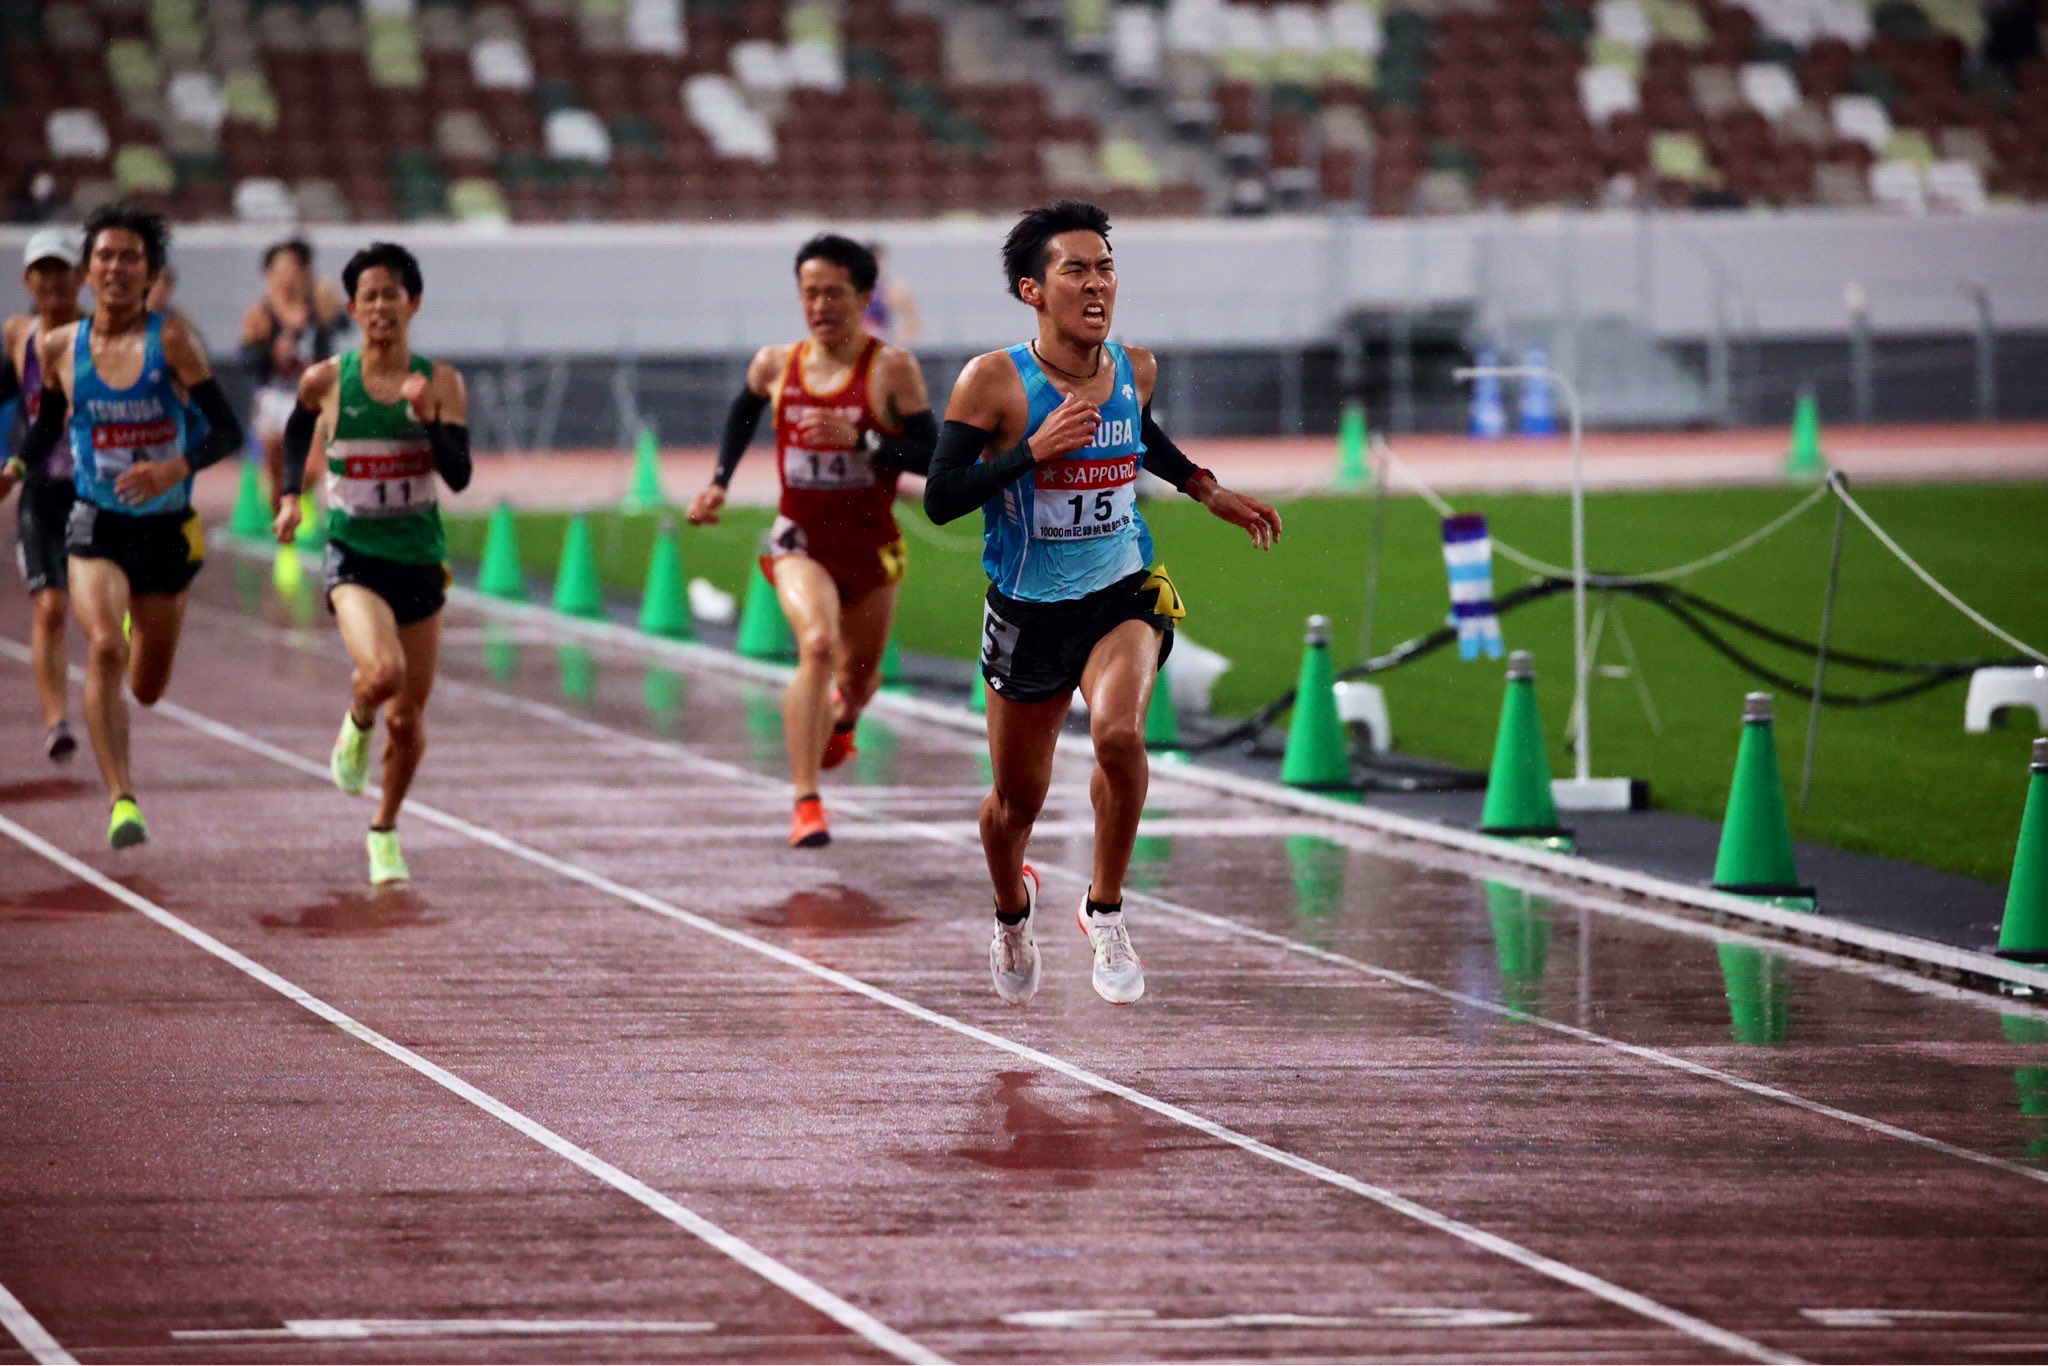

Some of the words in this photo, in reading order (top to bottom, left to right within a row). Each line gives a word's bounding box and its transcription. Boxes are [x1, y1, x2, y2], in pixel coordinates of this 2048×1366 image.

[808, 454, 846, 477] 14
[1063, 461, 1135, 484] SAPPORO
[375, 480, 411, 504] 11
[1068, 490, 1115, 525] 15
